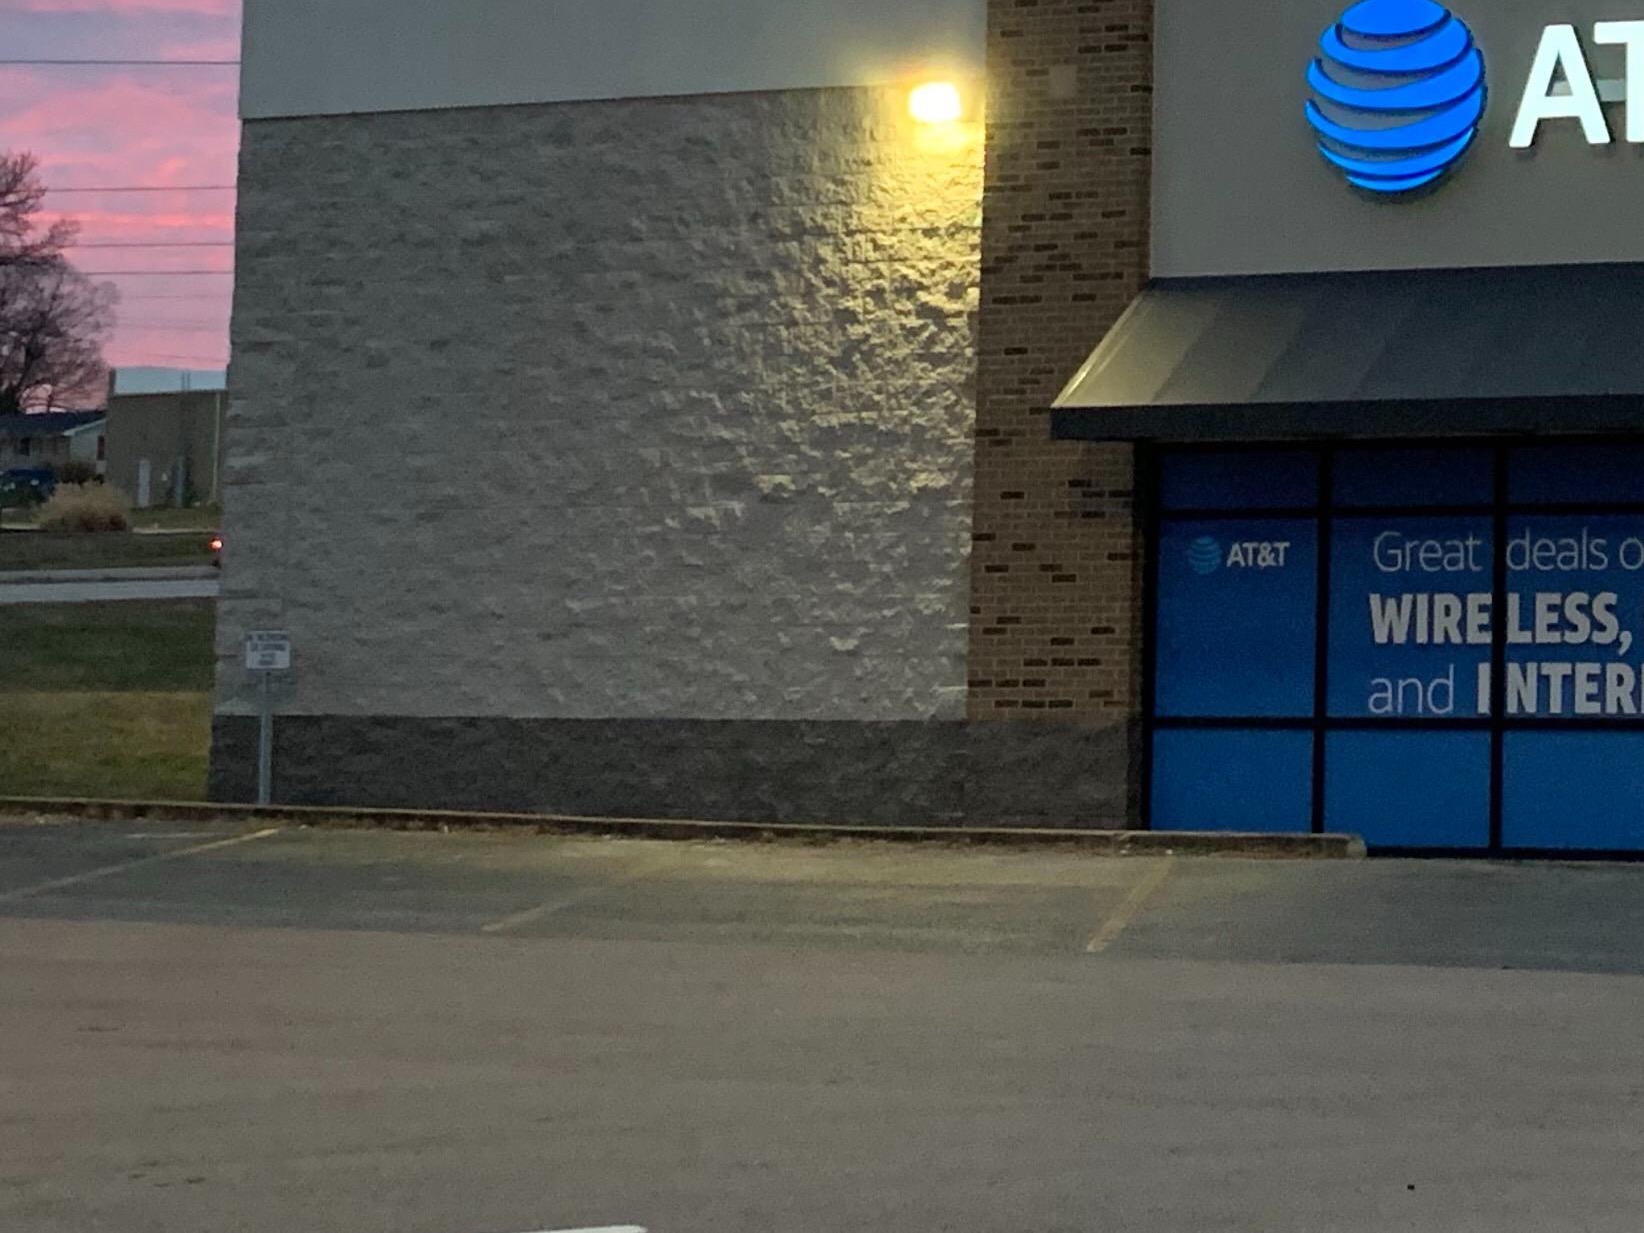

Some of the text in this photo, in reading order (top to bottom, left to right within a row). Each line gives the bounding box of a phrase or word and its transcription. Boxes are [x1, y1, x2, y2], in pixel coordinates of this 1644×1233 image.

[1226, 541, 1290, 569] AT&T
[1373, 530, 1482, 572] Great
[1506, 527, 1608, 571] deals
[1369, 592, 1633, 655] WIRELESS,
[1368, 664, 1455, 716] and
